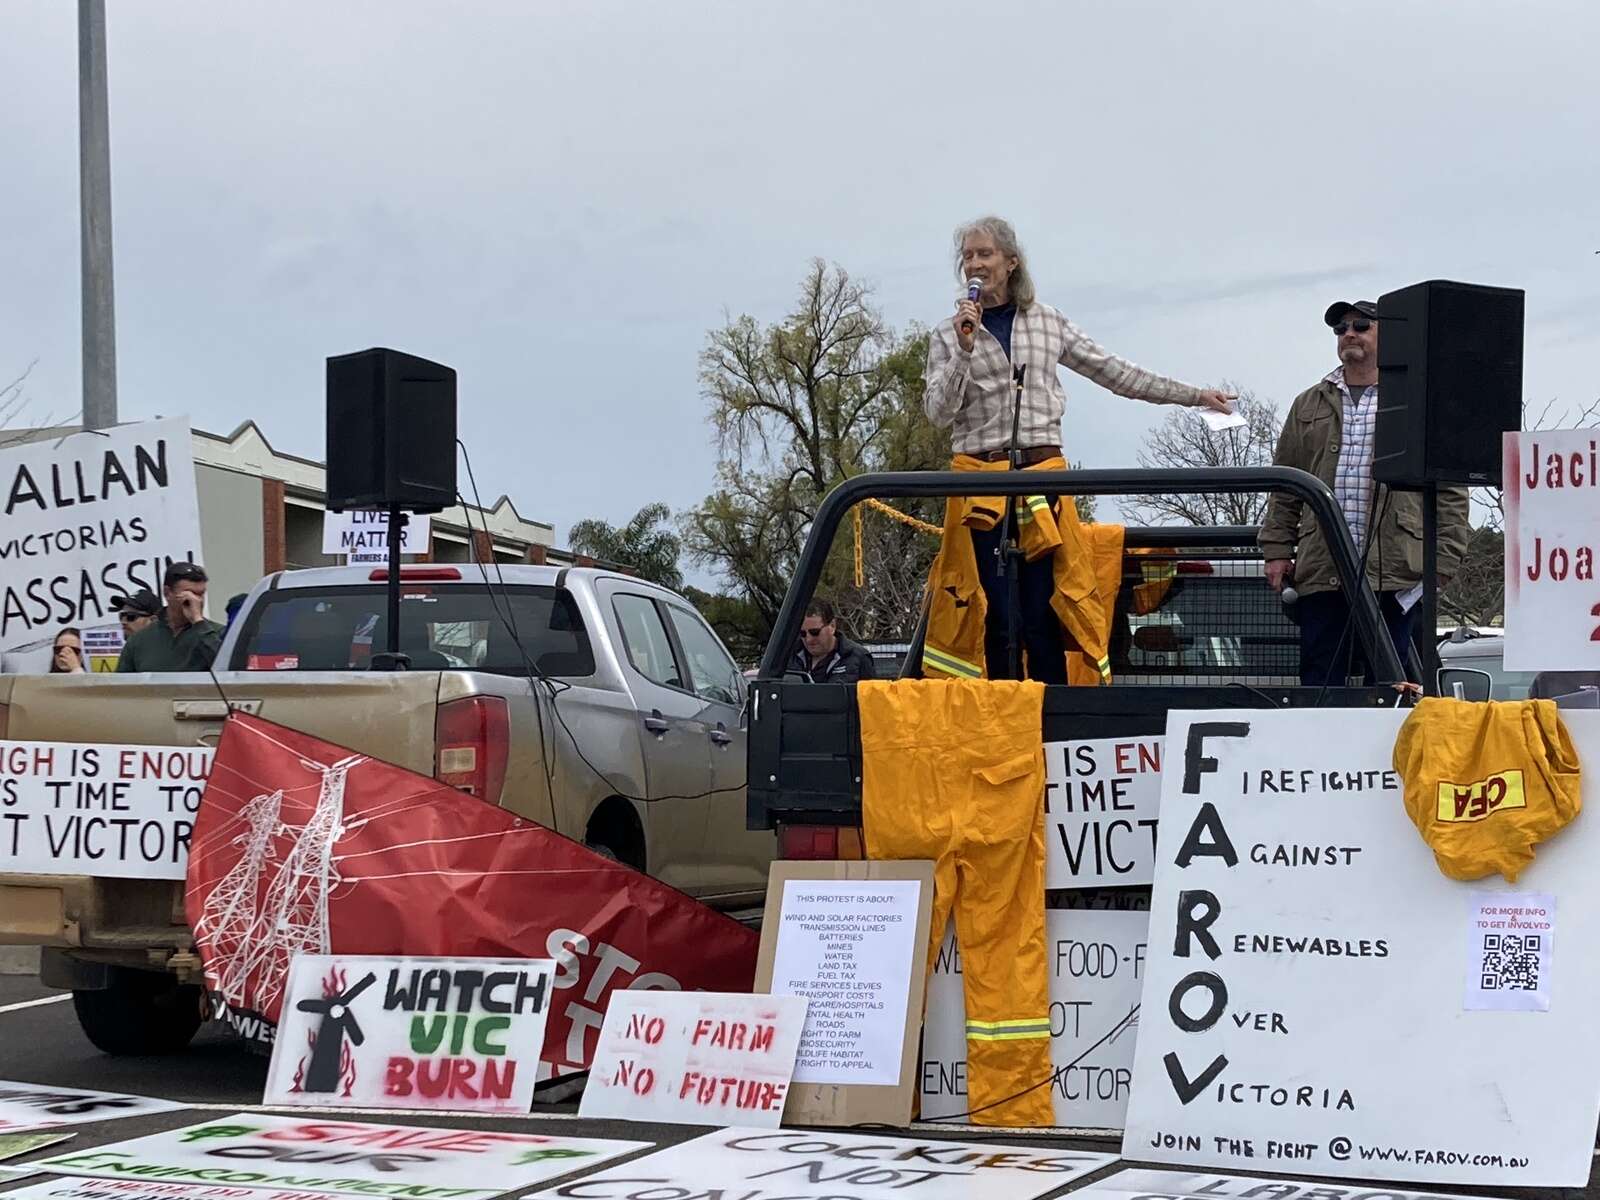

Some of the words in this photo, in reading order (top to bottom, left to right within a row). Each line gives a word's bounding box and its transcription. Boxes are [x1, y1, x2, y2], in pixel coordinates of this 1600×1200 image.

[5, 440, 168, 515] ALLAN
[1526, 441, 1597, 490] Jaci
[0, 517, 147, 559] VICTORIAS
[341, 531, 408, 547] MATTR
[1527, 538, 1593, 581] Joa
[2, 551, 193, 637] ASSASSI
[0, 747, 54, 776] GH
[71, 749, 99, 777] IS
[119, 751, 210, 780] ENOU
[1063, 745, 1096, 777] IS
[1115, 742, 1160, 774] EN
[0, 778, 18, 806] S
[45, 782, 130, 810] TIME
[159, 786, 201, 812] TO
[1044, 778, 1135, 814] TIME
[1453, 776, 1507, 818] CFA
[45, 815, 193, 863] VICTOR
[797, 895, 815, 903] THIS
[817, 895, 854, 903] PROTEST
[1480, 907, 1499, 915] FOR
[1499, 907, 1523, 916] MORE
[1525, 908, 1546, 917] INFO
[800, 924, 860, 932] TRANSMISSION
[819, 933, 864, 941] BATTERIES
[1477, 920, 1489, 928] TO
[1490, 921, 1506, 929] GET
[1508, 921, 1551, 930] INVOLVED
[818, 962, 840, 970] LAND
[842, 962, 857, 970] TAX
[383, 968, 548, 1014] WATCH
[795, 990, 844, 999] TRANSPORT
[846, 991, 875, 999] COSTS
[810, 981, 851, 989] SERVICES
[853, 982, 882, 990] LEVIES
[816, 1021, 845, 1029] ROADS
[833, 1011, 865, 1019] HEALTH
[409, 1015, 511, 1055] VIC
[626, 1013, 664, 1044] NO
[692, 1019, 775, 1052] FARM
[800, 1040, 856, 1048] BIOSECURITY
[838, 1031, 861, 1039] FARM
[830, 1060, 840, 1068] TO
[842, 1061, 874, 1069] APPEAL
[831, 1050, 863, 1058] HABITAT
[384, 1056, 517, 1099] BURN
[613, 1060, 654, 1095] NO
[680, 1071, 786, 1110] FUTURE
[1050, 1065, 1131, 1101] ACTOR
[258, 1124, 549, 1152] SAVE
[725, 1134, 1100, 1172] COCKIES
[1151, 1132, 1200, 1151] JOIN
[1214, 1136, 1254, 1158] THE
[1267, 1141, 1318, 1160] FIGHT
[206, 1145, 436, 1171] OUR
[41, 1152, 509, 1197] ENVIRONMENT
[745, 1161, 973, 1189] NOT
